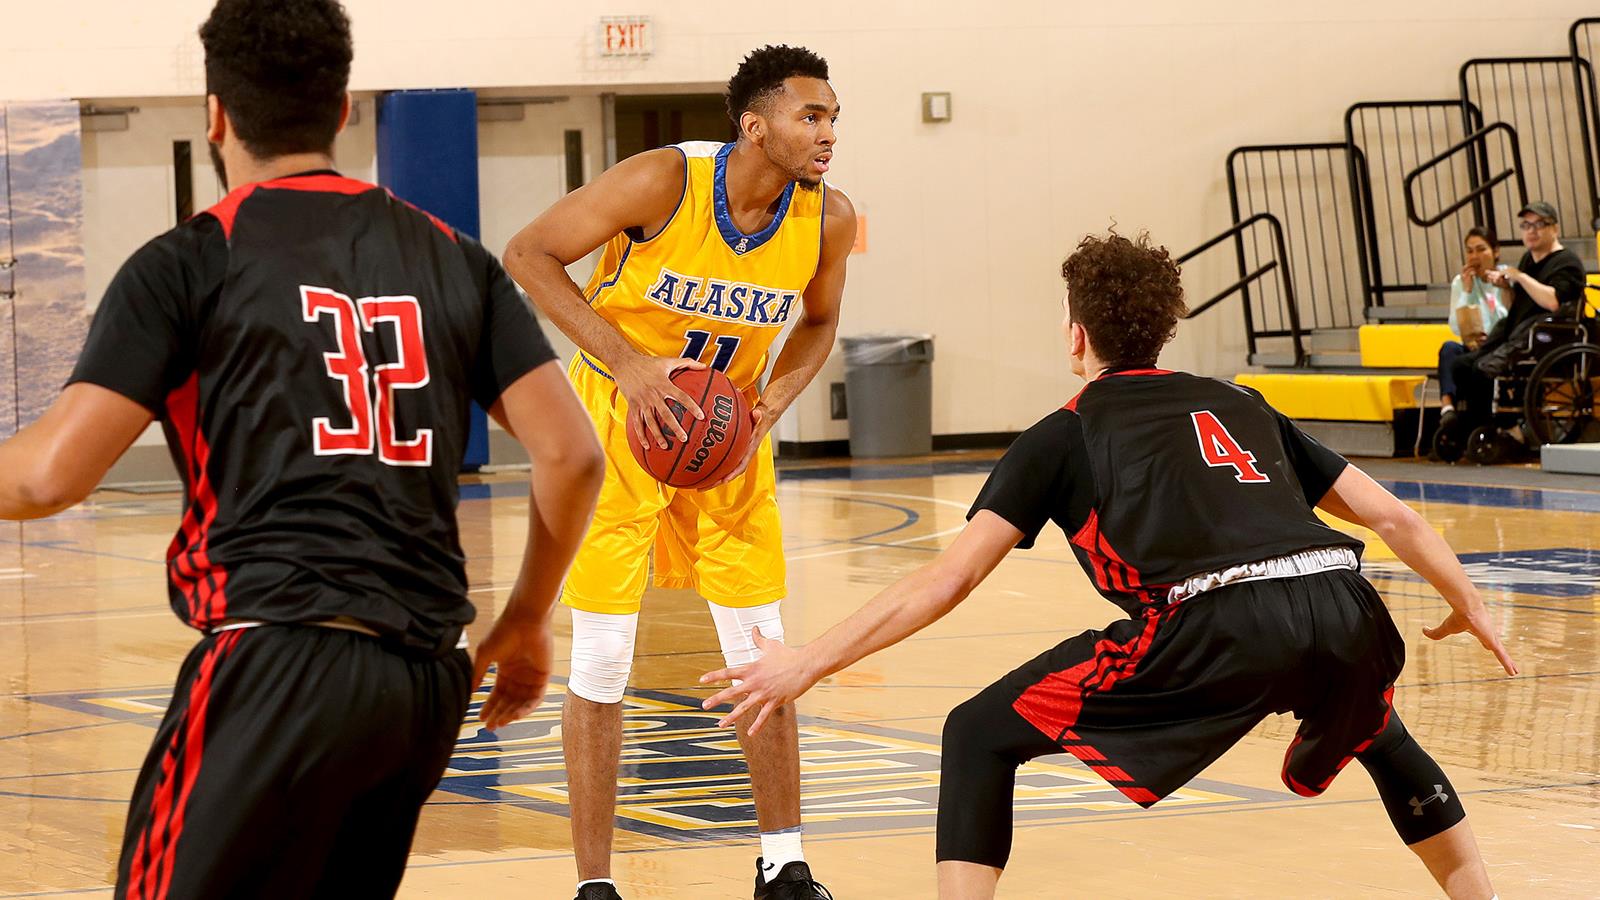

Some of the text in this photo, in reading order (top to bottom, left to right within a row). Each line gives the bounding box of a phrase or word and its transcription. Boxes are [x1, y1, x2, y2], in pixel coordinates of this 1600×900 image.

[605, 24, 648, 51] EXIT
[648, 270, 799, 326] ALASKA
[299, 285, 432, 467] 32
[679, 330, 741, 374] 11
[685, 394, 733, 472] Wilson
[1190, 410, 1270, 483] 4
